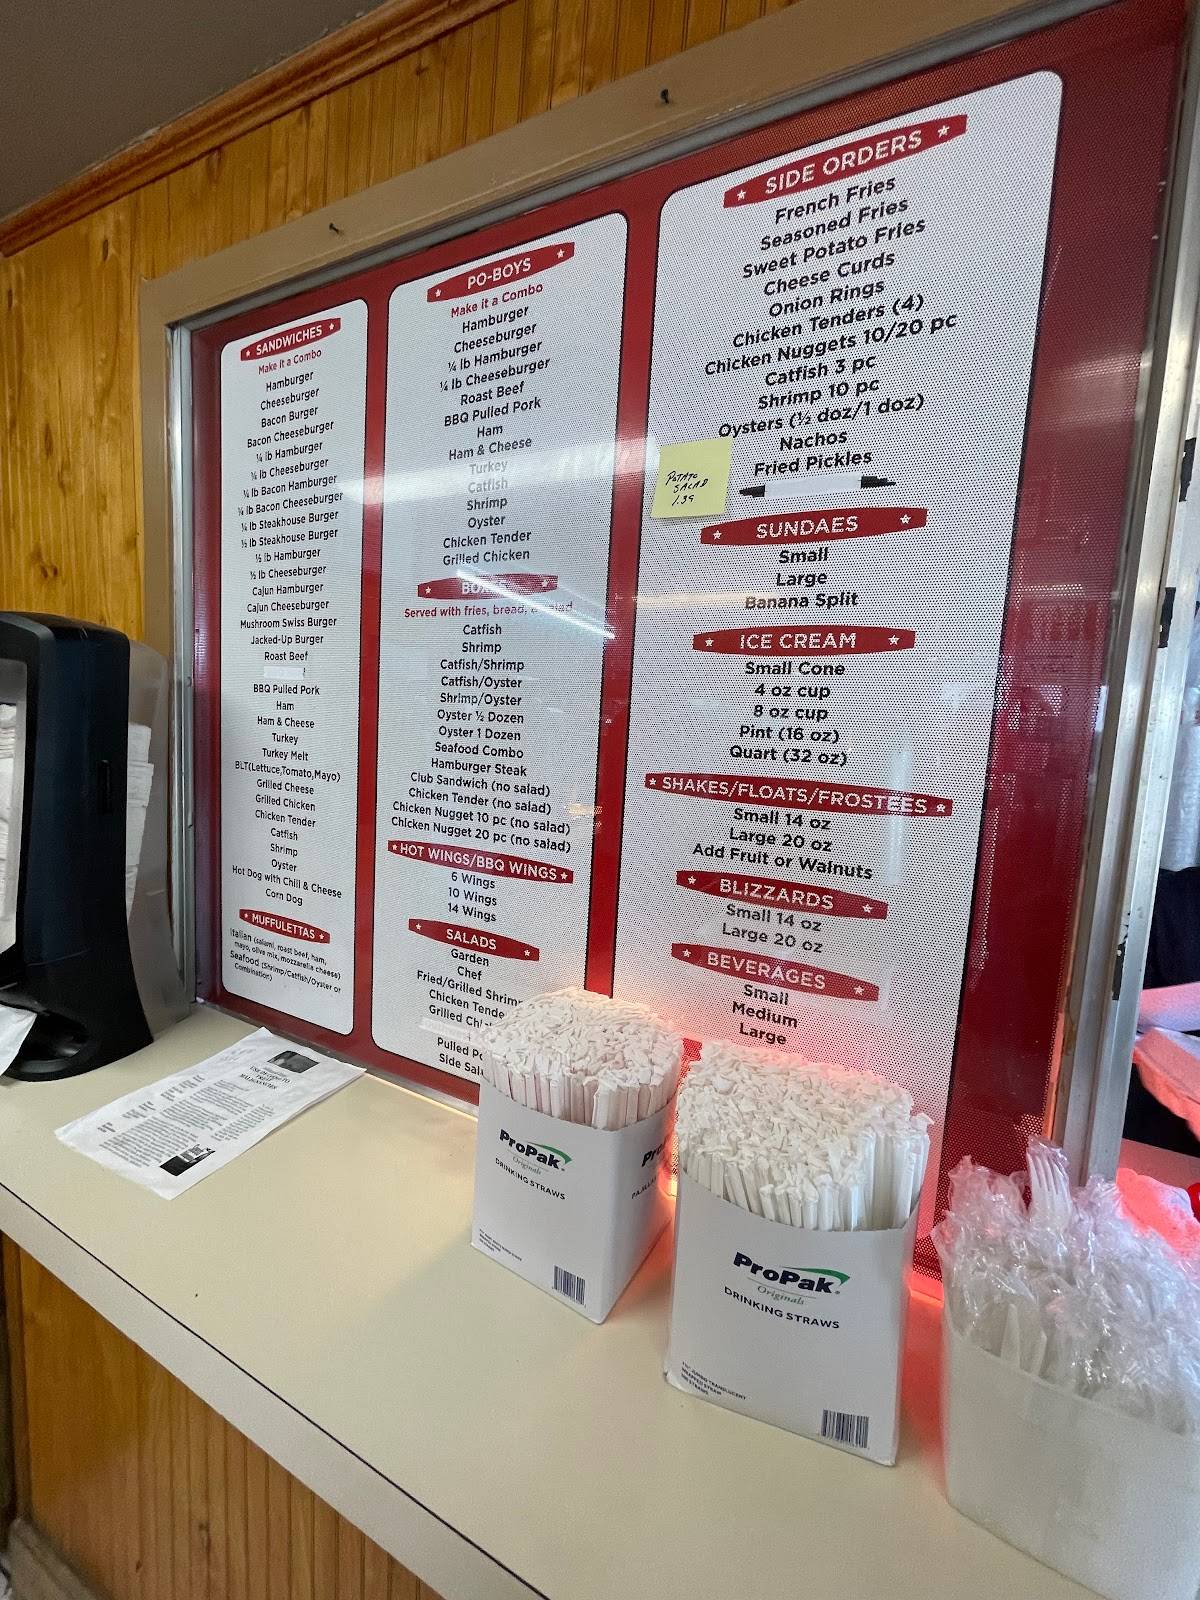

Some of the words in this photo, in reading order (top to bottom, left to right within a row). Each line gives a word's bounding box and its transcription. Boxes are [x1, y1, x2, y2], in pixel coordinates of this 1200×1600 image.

[765, 163, 815, 194] SIDE
[822, 130, 922, 175] ORDERS
[775, 192, 839, 225] French
[846, 177, 896, 203] Fries
[760, 213, 851, 251] Seasoned
[857, 199, 909, 224] Fries
[742, 254, 797, 278] Sweet
[803, 235, 868, 263] Potato
[875, 219, 927, 245] Fries
[467, 258, 531, 289] PO-BOYS
[763, 270, 830, 296] Cheese
[837, 252, 895, 278] Curds
[451, 303, 478, 318] Make
[481, 298, 489, 309] it
[492, 298, 498, 306] a
[502, 283, 543, 303] Combo
[769, 292, 823, 317] Onion
[830, 281, 884, 307] Rings
[462, 306, 529, 333] Hamburger
[732, 324, 802, 348] Chicken
[809, 304, 885, 332] Tenders
[891, 293, 924, 317] (4)
[256, 325, 322, 356] SANDWICHES
[454, 323, 536, 353] Cheeseburger
[705, 352, 772, 376] Chicken
[777, 334, 857, 361] Nuggets
[863, 320, 923, 345] 10/20
[930, 314, 958, 334] pc
[460, 358, 470, 370] lb
[474, 341, 542, 368] Hamburger
[266, 371, 314, 392] Hamburger
[765, 363, 828, 386] Catfish
[835, 359, 845, 374] 3
[851, 355, 877, 373] pc
[261, 387, 319, 410] Cheeseburger
[461, 390, 492, 405] Roast
[497, 381, 525, 398] Beef
[758, 388, 822, 409] Shrimp
[829, 383, 849, 398] 10
[855, 378, 880, 395] pc
[261, 414, 286, 427] Bacon
[289, 405, 318, 423] Burger
[445, 413, 469, 426] BBQ
[472, 403, 508, 422] Pulled
[513, 397, 541, 413] Pork
[718, 417, 783, 438] Oysters
[789, 411, 812, 430] (½
[817, 401, 871, 424] doz/1
[878, 393, 924, 416] doz)
[247, 433, 271, 448] Bacon
[274, 420, 334, 442] Cheeseburger
[779, 431, 849, 451] Nachos
[449, 446, 474, 461] Ham
[476, 444, 485, 456] &
[490, 438, 532, 454] Cheese
[754, 454, 800, 477] Fried
[805, 451, 872, 471] Pickles
[467, 497, 508, 511] Shrimp
[468, 514, 505, 528] Oyster
[756, 516, 859, 539] SUNDAES
[443, 536, 486, 549] Chicken
[491, 530, 532, 544] Tender
[779, 547, 829, 563] Small
[776, 572, 828, 589] Large
[745, 596, 809, 610] Banana
[815, 592, 859, 610] Split
[240, 619, 280, 629] Mushroom
[282, 619, 304, 627] Swiss
[308, 618, 337, 627] Burger
[251, 635, 293, 645] Jacked-Up
[295, 635, 323, 645] Burger
[740, 634, 772, 649] ICE
[779, 633, 856, 649] CREAM
[264, 652, 286, 660] Roast
[289, 652, 308, 660] Beef
[440, 659, 524, 672] Catfish/Shrimp
[745, 662, 792, 675] Small
[798, 662, 845, 675] Cone
[254, 684, 270, 693] BBQ
[273, 685, 297, 694] Pulled
[300, 686, 320, 695] Pork
[441, 677, 522, 690] Catfish/Oyster
[755, 684, 765, 697] 4
[772, 686, 791, 697] oz
[797, 685, 831, 700] cup
[276, 701, 294, 710] Ham
[440, 693, 522, 707] Shrimp/Oyster
[754, 705, 763, 718] 8
[769, 707, 789, 719] oz
[795, 708, 828, 722] cup
[272, 733, 298, 744] Turkey
[740, 726, 773, 739] Pint
[778, 726, 804, 741] (16
[810, 729, 840, 744] oz)
[262, 748, 288, 760] Turkey
[291, 751, 308, 760] Melt
[435, 742, 479, 755] Seafood
[483, 745, 524, 758] Combo
[730, 746, 776, 760] Quart
[783, 748, 811, 764] (32
[818, 750, 848, 766] oz)
[431, 758, 491, 773] Hamburger
[495, 765, 527, 776] Steak
[662, 777, 927, 813] SHAKES/FLOATS/FROSTEES
[734, 808, 778, 825] Small
[785, 813, 804, 826] 14
[810, 818, 832, 830] oz
[270, 828, 298, 841] Catfish
[730, 827, 776, 846] Large
[782, 834, 805, 848] 20
[811, 839, 833, 852] oz
[270, 843, 298, 857] Shrimp
[693, 843, 725, 859] Add
[730, 849, 769, 865] Fruit
[774, 856, 793, 867] or
[799, 857, 873, 879] Walnuts
[271, 859, 296, 872] Oyster
[400, 843, 424, 856] HOT
[428, 847, 505, 871] WINGS/BBQ
[509, 861, 557, 880] WINGS
[266, 889, 283, 900] Corn
[286, 892, 302, 906] Dog
[449, 887, 459, 898] 10
[464, 889, 497, 906] Wings
[719, 879, 834, 909] BLIZZARDS
[252, 913, 315, 939] MUFFULETTAS
[726, 903, 771, 923] Small
[777, 912, 794, 927] 14
[801, 919, 822, 931] oz
[446, 929, 497, 949] SALADS
[722, 923, 768, 943] Large
[774, 933, 796, 948] 20
[802, 940, 823, 953] oz
[451, 949, 489, 966] Garden
[457, 966, 482, 980] Chef
[707, 952, 826, 989] BEVERAGES
[743, 984, 789, 1005] Small
[732, 1001, 798, 1027] Medium
[739, 1022, 787, 1046] Large
[499, 1129, 560, 1170] ProPak
[512, 1156, 542, 1175] Originals
[495, 1158, 528, 1184] DRINKING
[530, 1180, 566, 1200] STRAWS
[733, 1252, 834, 1294] ProPak
[757, 1285, 805, 1305] Originals
[724, 1286, 783, 1317] DRINKING
[786, 1312, 840, 1329] STRAWS
